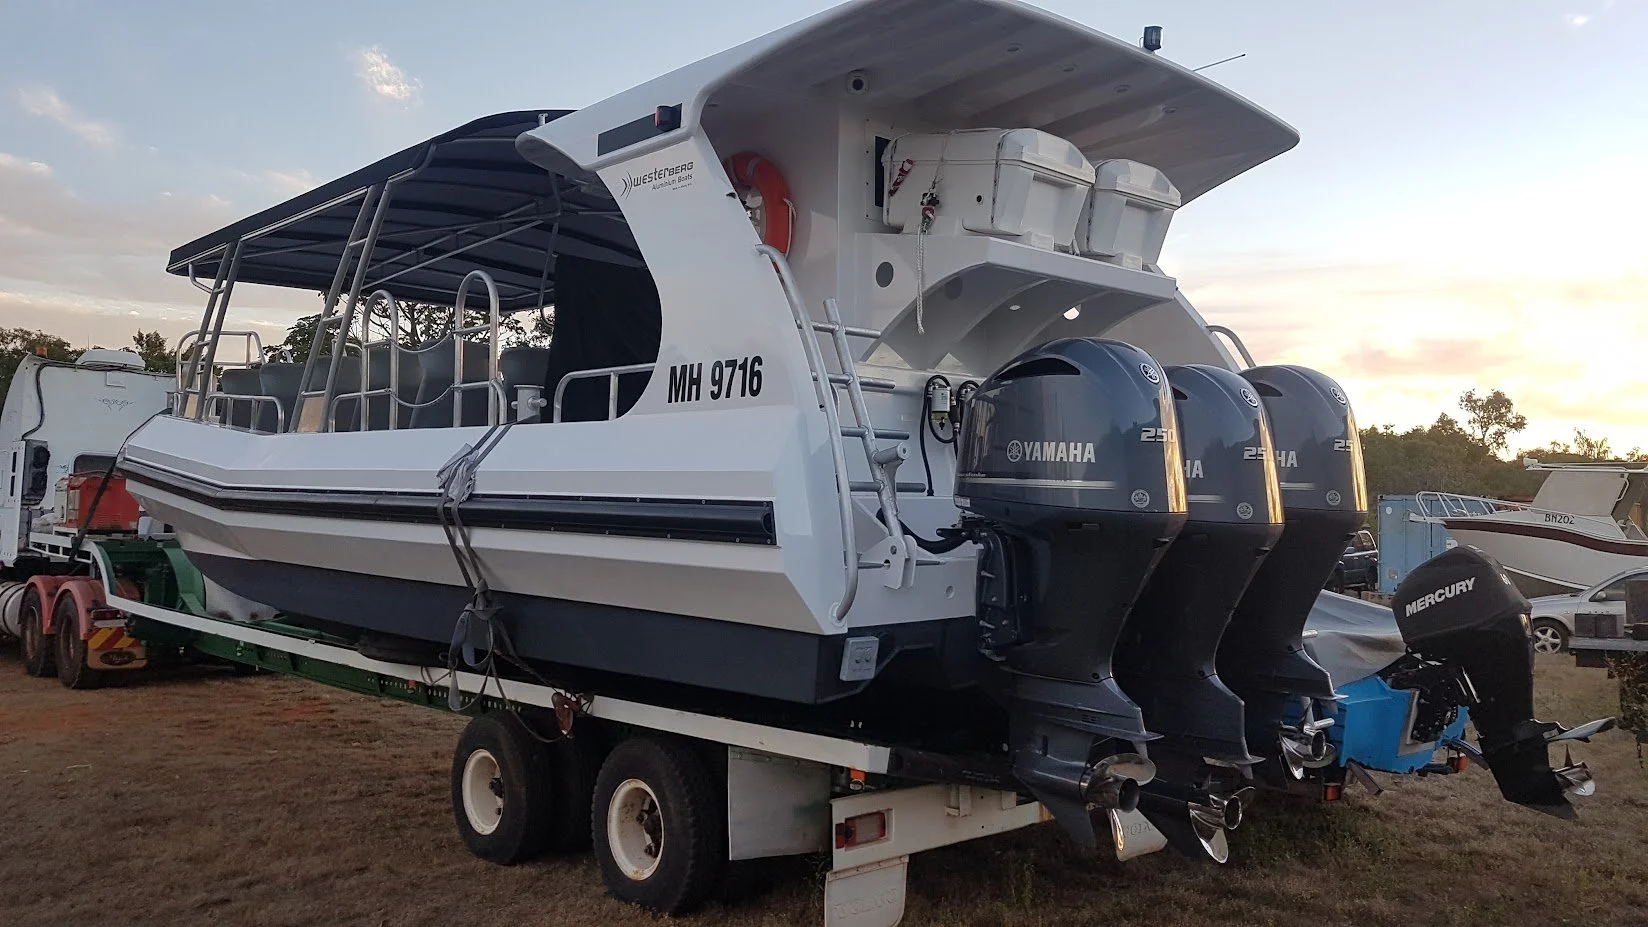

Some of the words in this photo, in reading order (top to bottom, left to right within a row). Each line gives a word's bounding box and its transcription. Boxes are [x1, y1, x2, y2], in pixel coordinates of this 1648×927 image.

[667, 363, 703, 404] MH
[710, 355, 763, 401] 9716
[1023, 441, 1096, 463] YAMAHA
[1404, 577, 1476, 618] MERCURY
